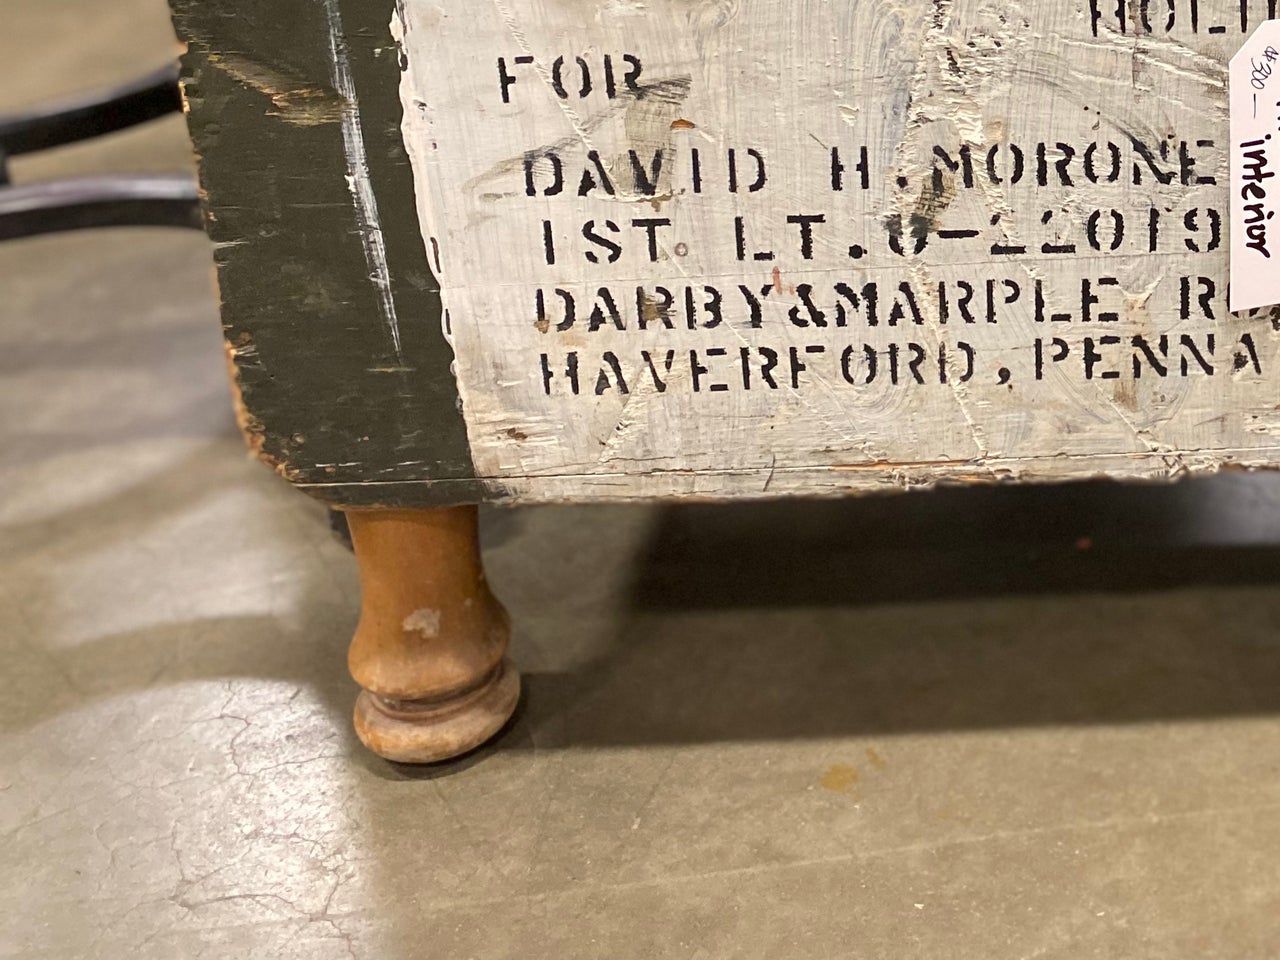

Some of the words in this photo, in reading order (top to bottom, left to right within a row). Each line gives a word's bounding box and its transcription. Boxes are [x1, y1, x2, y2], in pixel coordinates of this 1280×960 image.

[498, 53, 643, 103] FOR
[524, 145, 768, 197] DAVID
[1239, 134, 1275, 259] interior
